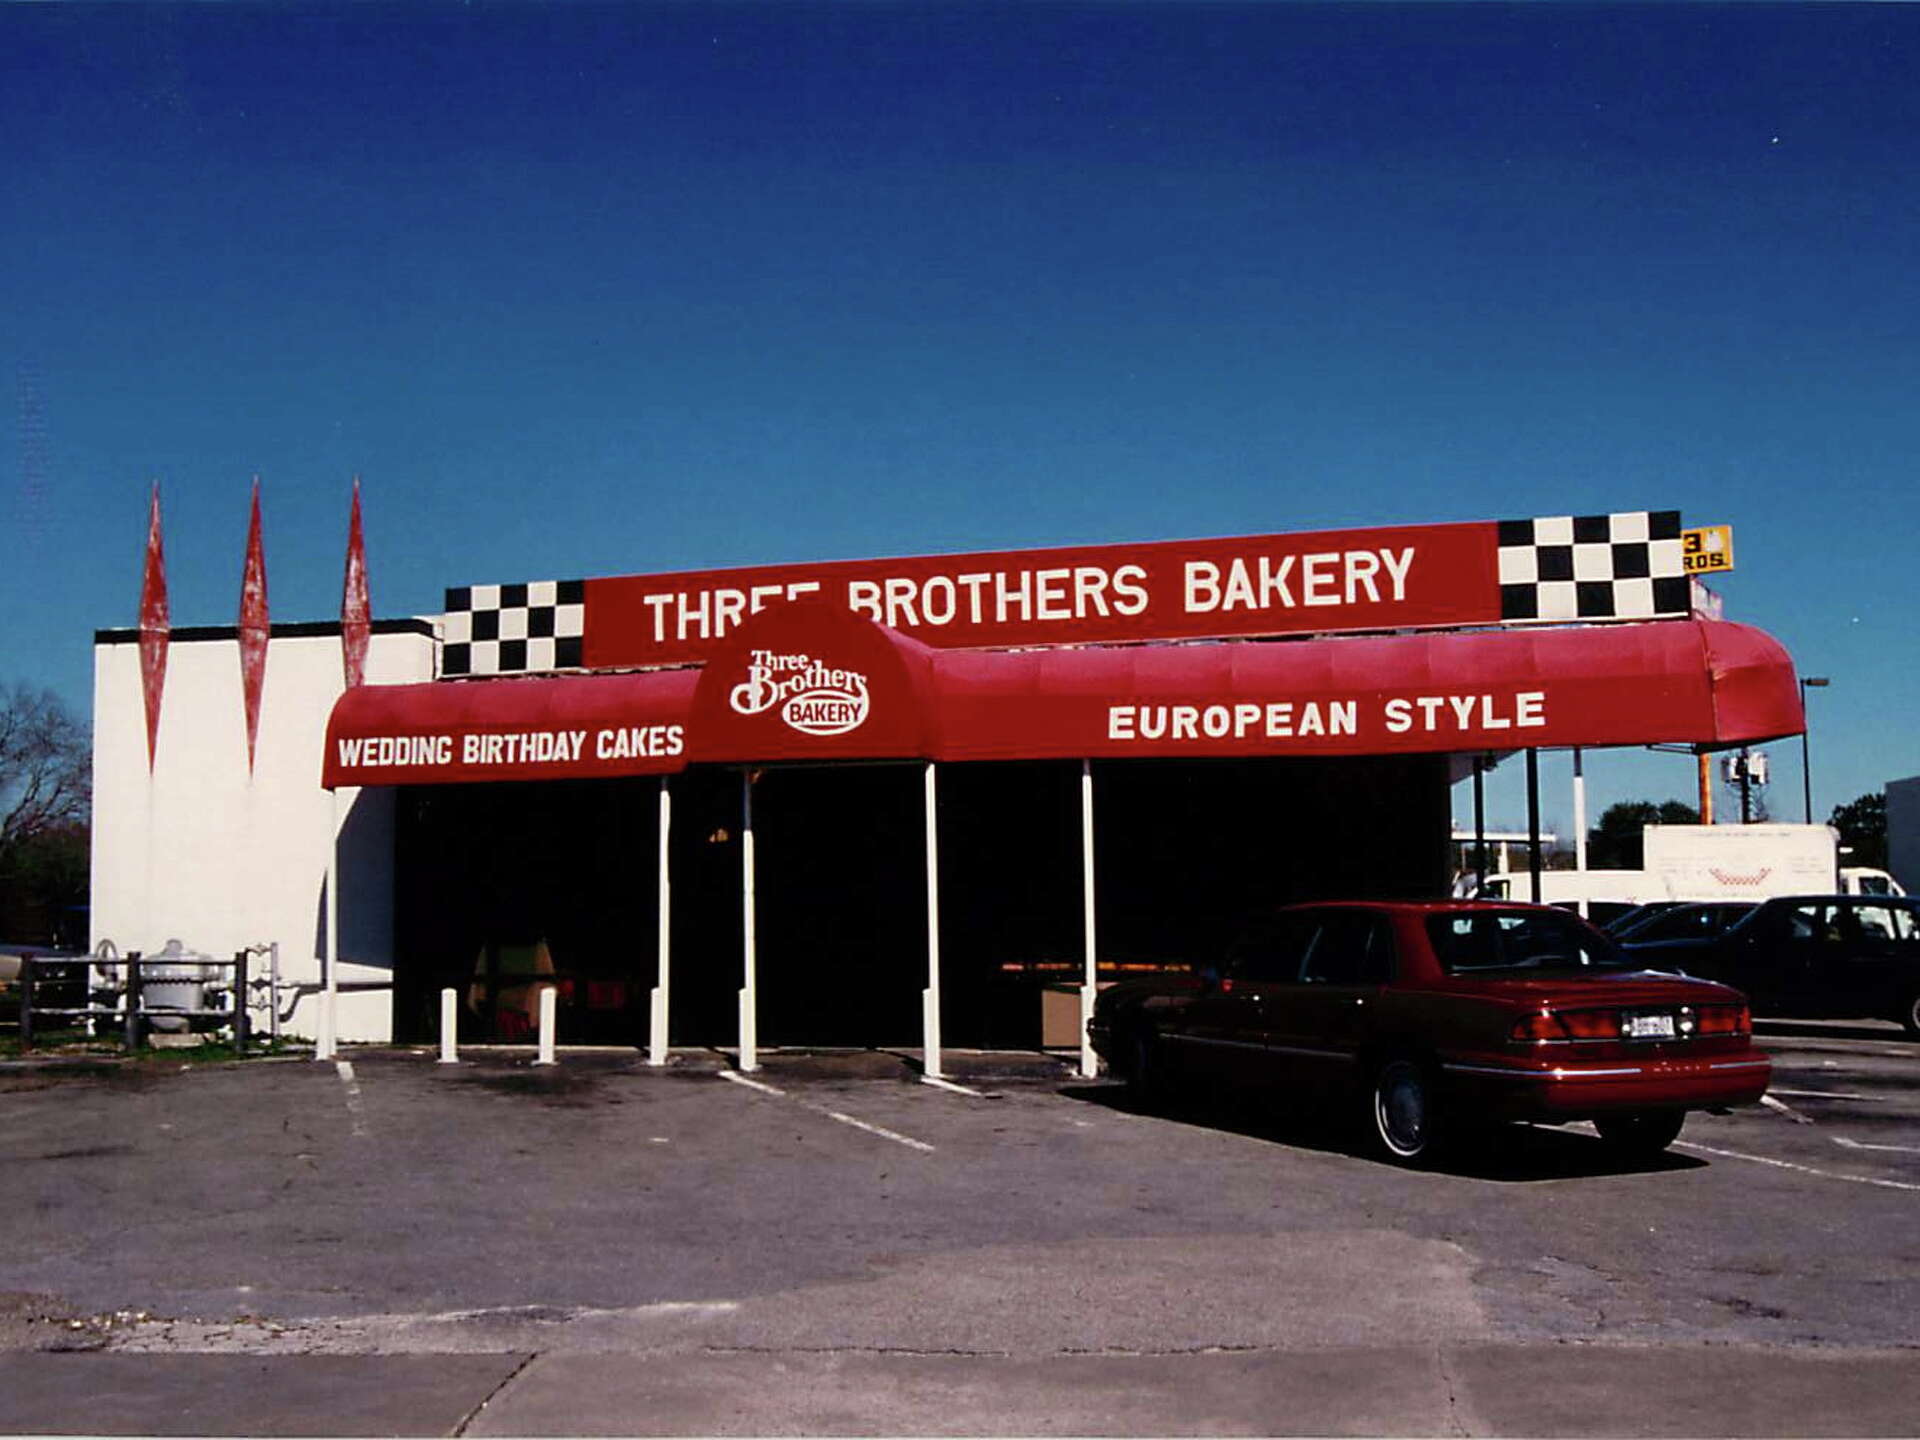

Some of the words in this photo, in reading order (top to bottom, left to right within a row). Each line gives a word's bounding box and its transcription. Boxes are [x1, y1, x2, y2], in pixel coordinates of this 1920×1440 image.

[1683, 533, 1701, 553] 3
[849, 564, 1149, 628] BROTHERS
[1184, 547, 1415, 613] BAKERY
[751, 650, 808, 671] Three
[730, 660, 868, 714] Brothers
[789, 703, 862, 722] BAKERY
[1108, 700, 1358, 740] EUROPEAN
[1384, 691, 1546, 733] STYLE
[338, 736, 453, 767] WEDDING
[462, 730, 587, 764] BIRTHDAY
[596, 725, 685, 760] CAKES
